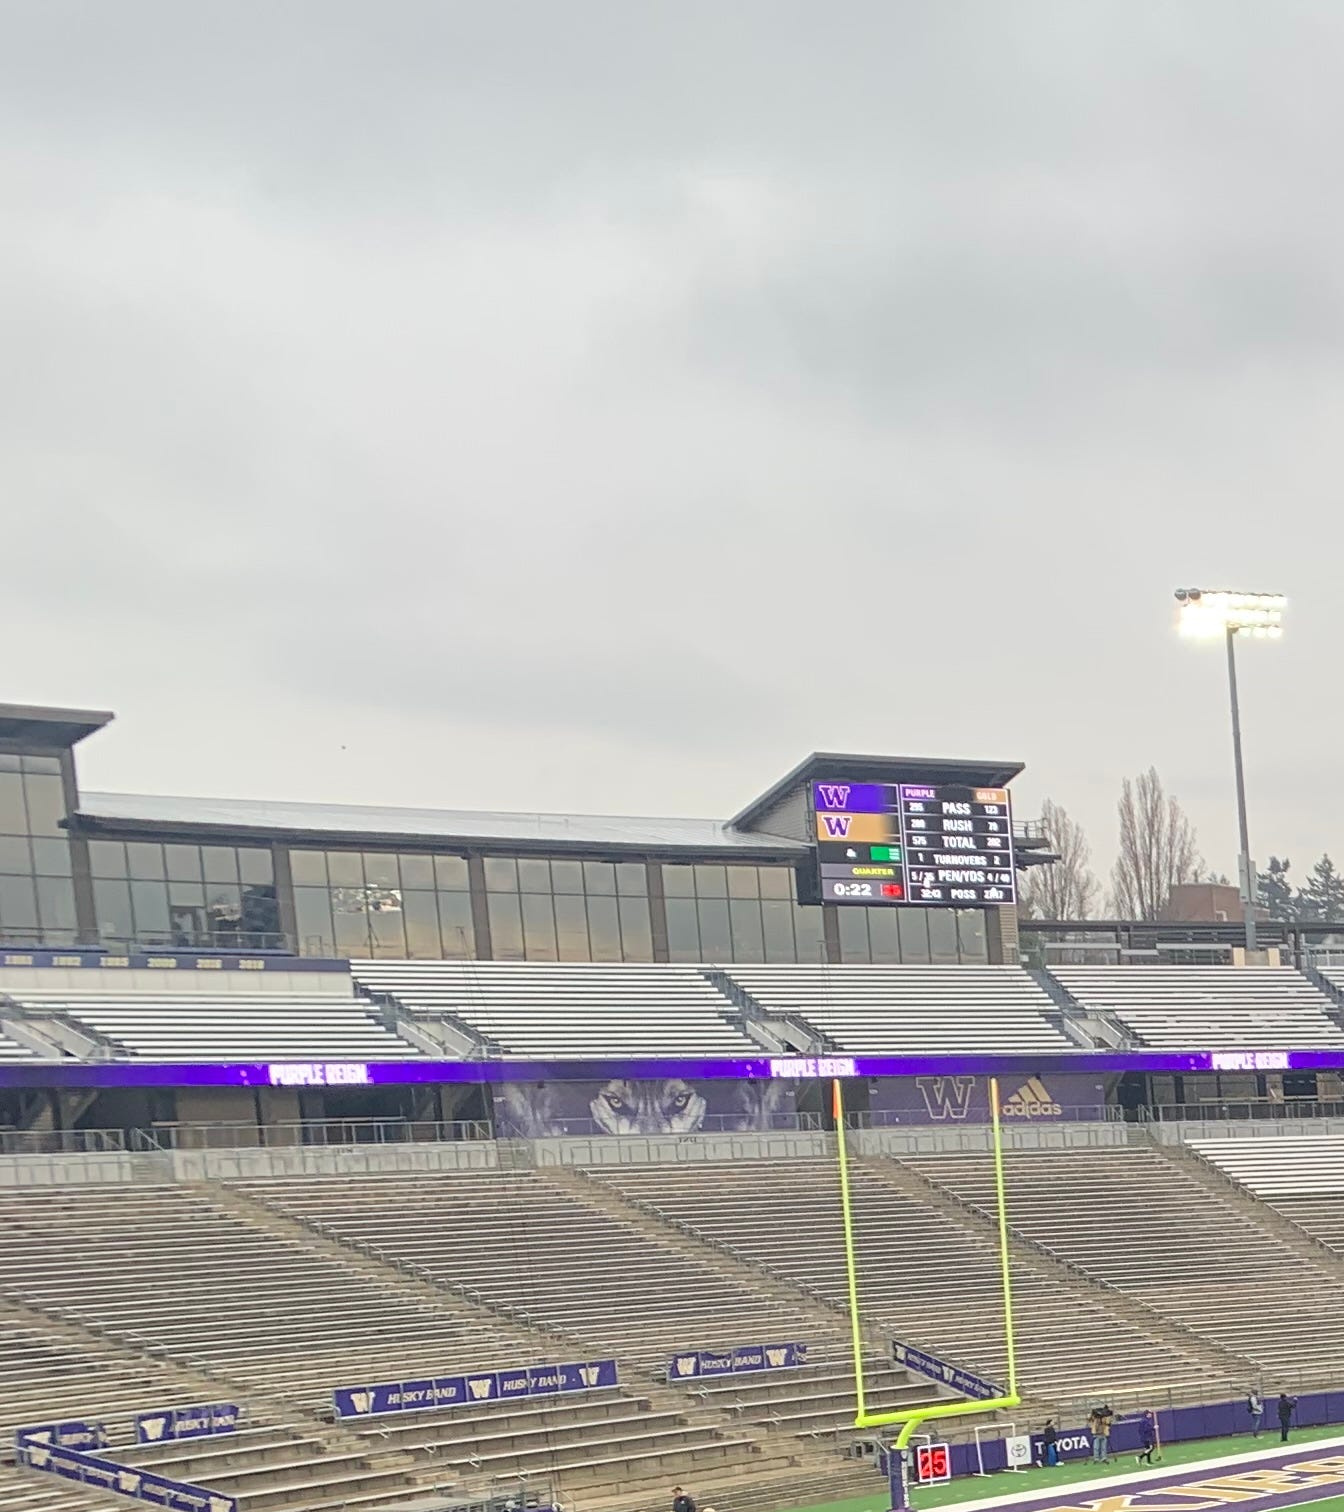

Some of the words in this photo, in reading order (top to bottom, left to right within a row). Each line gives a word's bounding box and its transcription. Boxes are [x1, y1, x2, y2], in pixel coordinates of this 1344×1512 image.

[819, 785, 850, 808] W
[905, 788, 936, 798] PURPLE
[942, 802, 972, 814] PASS
[822, 815, 852, 837] W
[942, 819, 973, 831] RUSH
[941, 836, 976, 849] TOTAL
[933, 854, 988, 865] TURNOVERS
[852, 867, 895, 876] QUARTER
[938, 870, 985, 882] PEN/YDS
[833, 883, 872, 896] 0:22
[951, 889, 977, 899] POSS
[771, 1059, 815, 1077] PURPLE
[817, 1059, 856, 1077] REIGN
[1212, 1053, 1254, 1069] PURPLE
[269, 1064, 324, 1085] PURPLE
[325, 1064, 369, 1084] REIGN
[916, 1076, 975, 1119] W
[1002, 1102, 1062, 1118] adidas
[677, 1357, 696, 1375] W
[734, 1354, 763, 1367] BAND
[766, 1348, 788, 1367] W
[350, 1391, 375, 1414] W
[387, 1389, 426, 1405] HUSKY
[426, 1386, 457, 1402] BAND
[469, 1379, 492, 1399] W
[578, 1366, 600, 1387] W
[1035, 1434, 1091, 1455] TYOTA
[920, 1450, 948, 1477] 25
